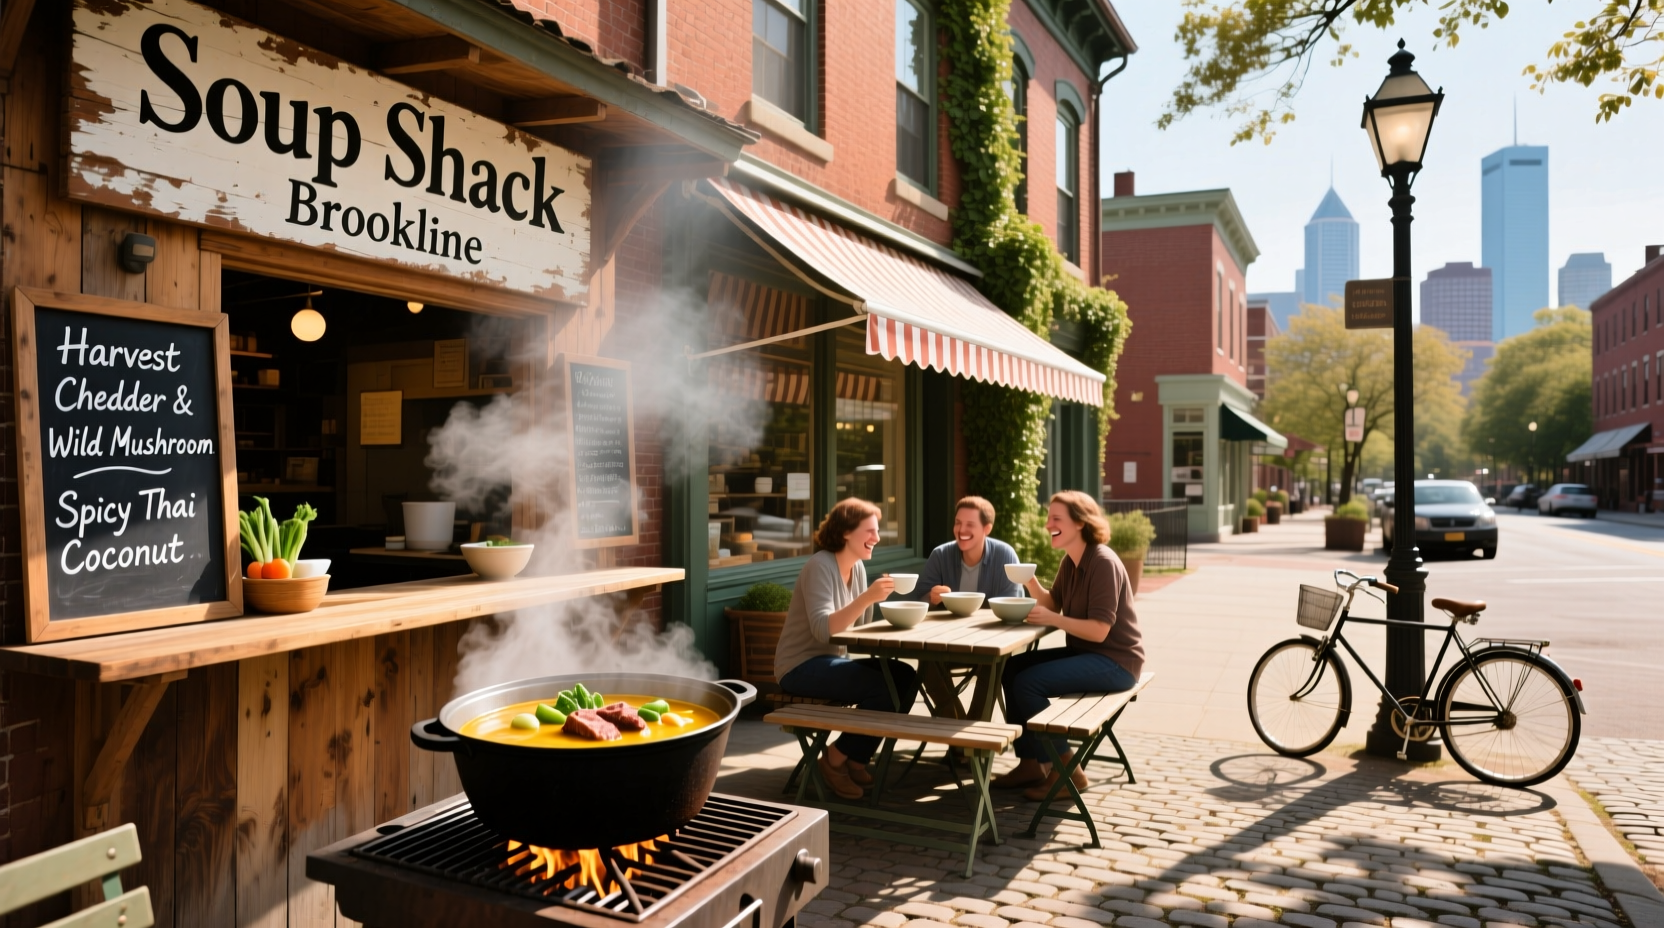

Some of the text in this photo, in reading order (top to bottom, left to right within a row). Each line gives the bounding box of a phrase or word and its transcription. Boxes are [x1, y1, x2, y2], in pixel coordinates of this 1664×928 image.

[139, 22, 566, 235] Soup Shack
[284, 178, 483, 266] Brookline
[56, 326, 181, 372] Harvest
[54, 376, 194, 416] Chedder &
[49, 425, 214, 458] Wild Mushroom
[55, 487, 197, 538] Spicy Thai
[60, 533, 184, 576] Coconut
